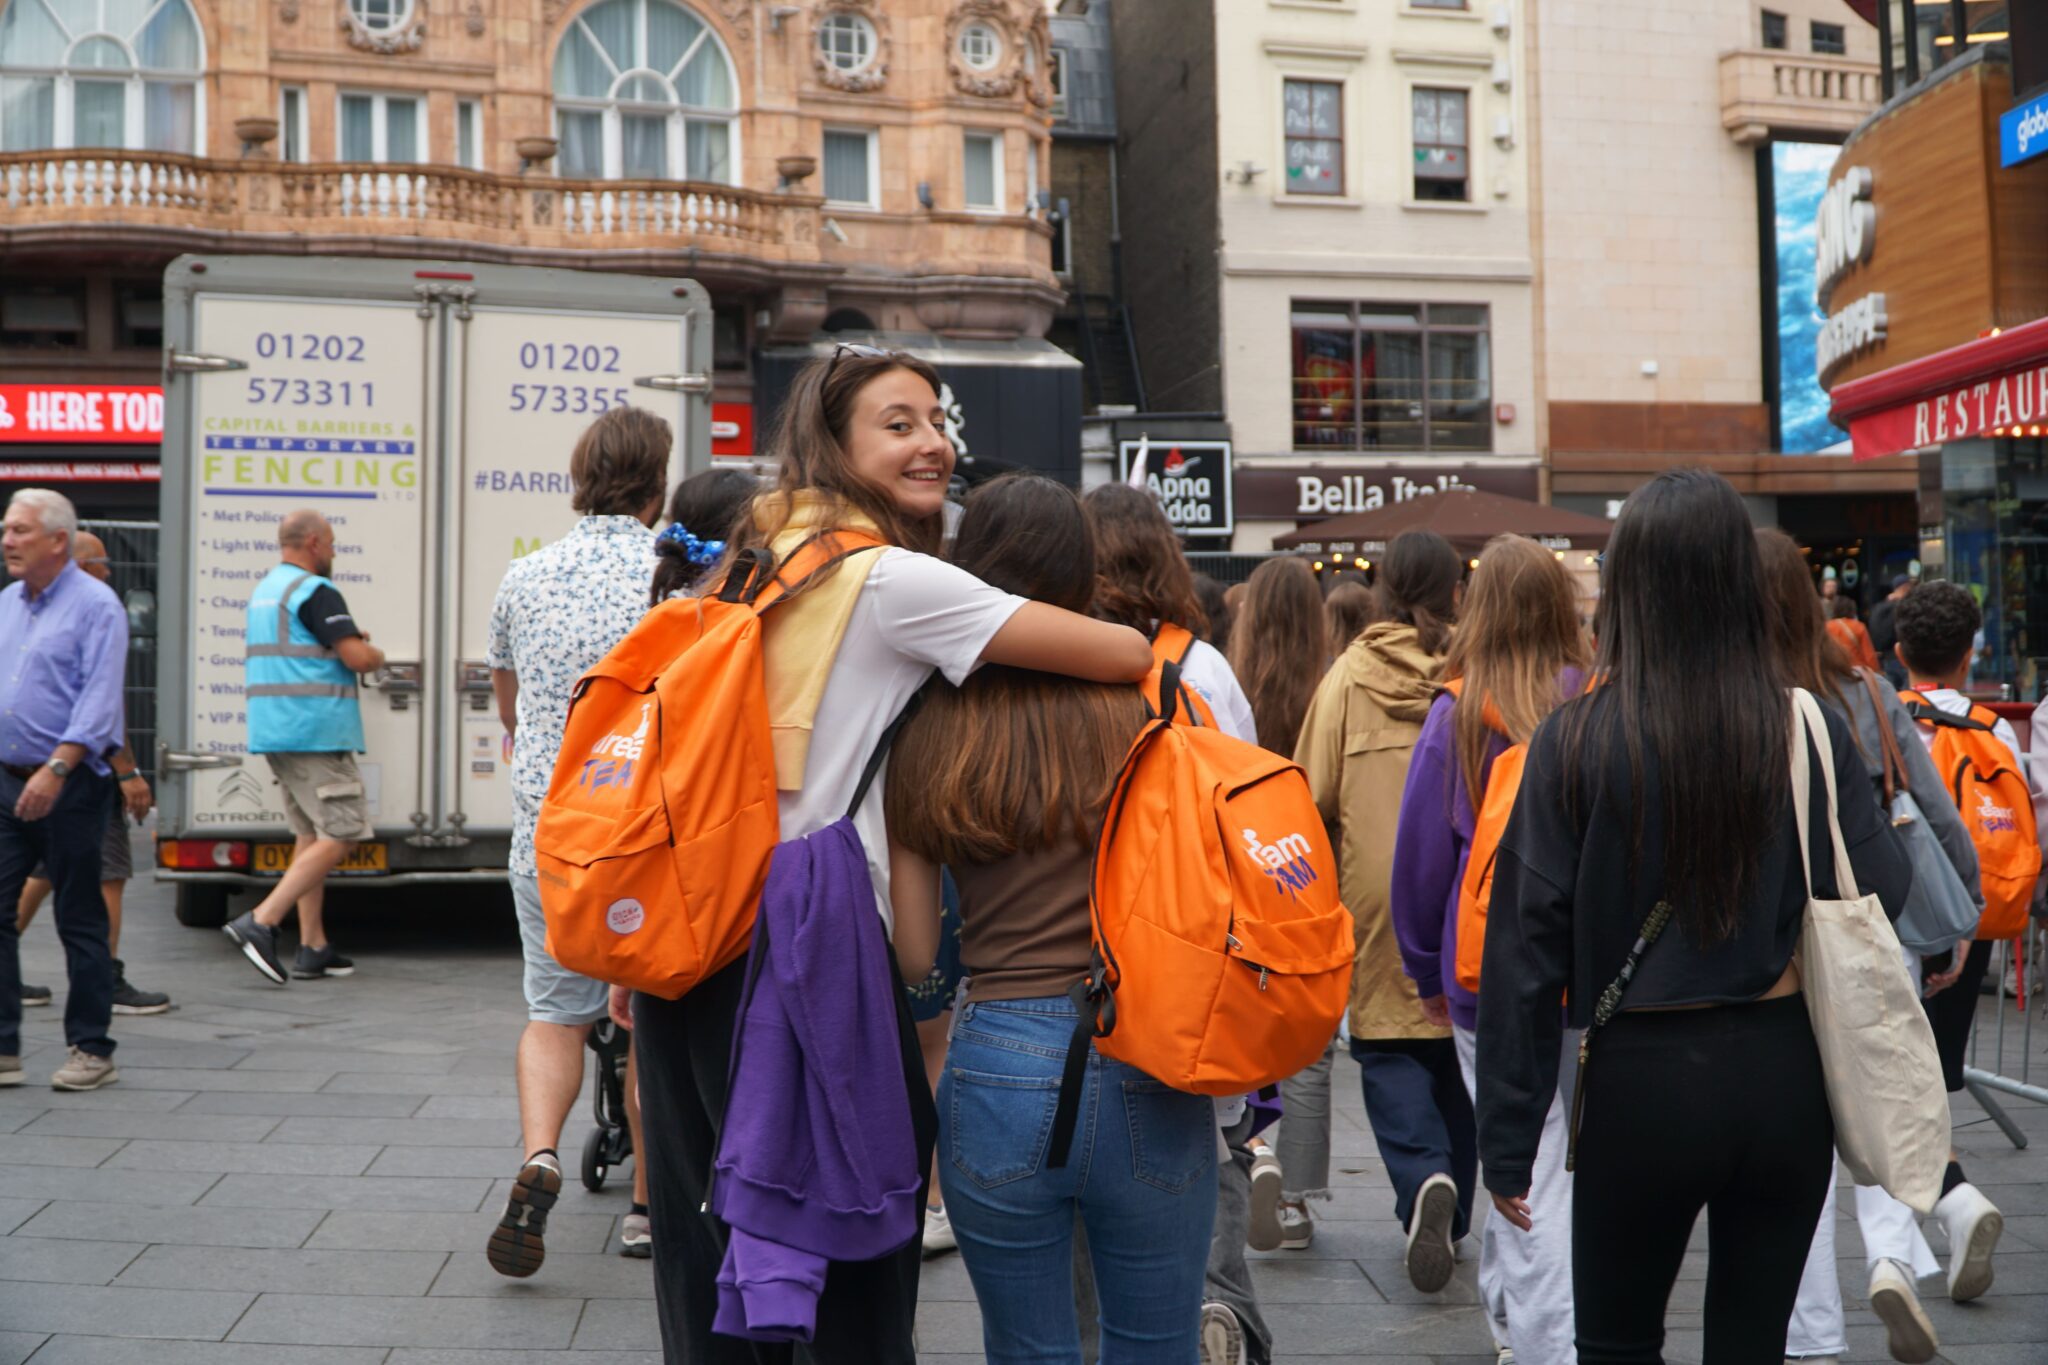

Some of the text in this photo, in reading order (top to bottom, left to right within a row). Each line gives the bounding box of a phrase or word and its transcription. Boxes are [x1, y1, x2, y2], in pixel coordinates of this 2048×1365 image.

[2017, 104, 2048, 153] glob
[256, 332, 366, 362] 01202
[519, 342, 621, 373] 01202
[247, 378, 374, 407] 573311
[509, 383, 629, 414] 573355
[26, 391, 105, 432] HERE
[204, 417, 287, 433] CAPITAL
[296, 420, 394, 436] BARRIERS
[211, 436, 410, 454] TEMPORARY
[203, 455, 416, 488] FENCING
[474, 470, 576, 494] #BARRI
[1147, 472, 1211, 505] Apna
[1297, 475, 1384, 513] Bella
[213, 510, 241, 522] Met
[212, 540, 250, 554] Light
[212, 567, 251, 579] Front
[210, 683, 246, 694] Whit
[210, 711, 233, 724] VIP
[208, 740, 249, 752] Stret
